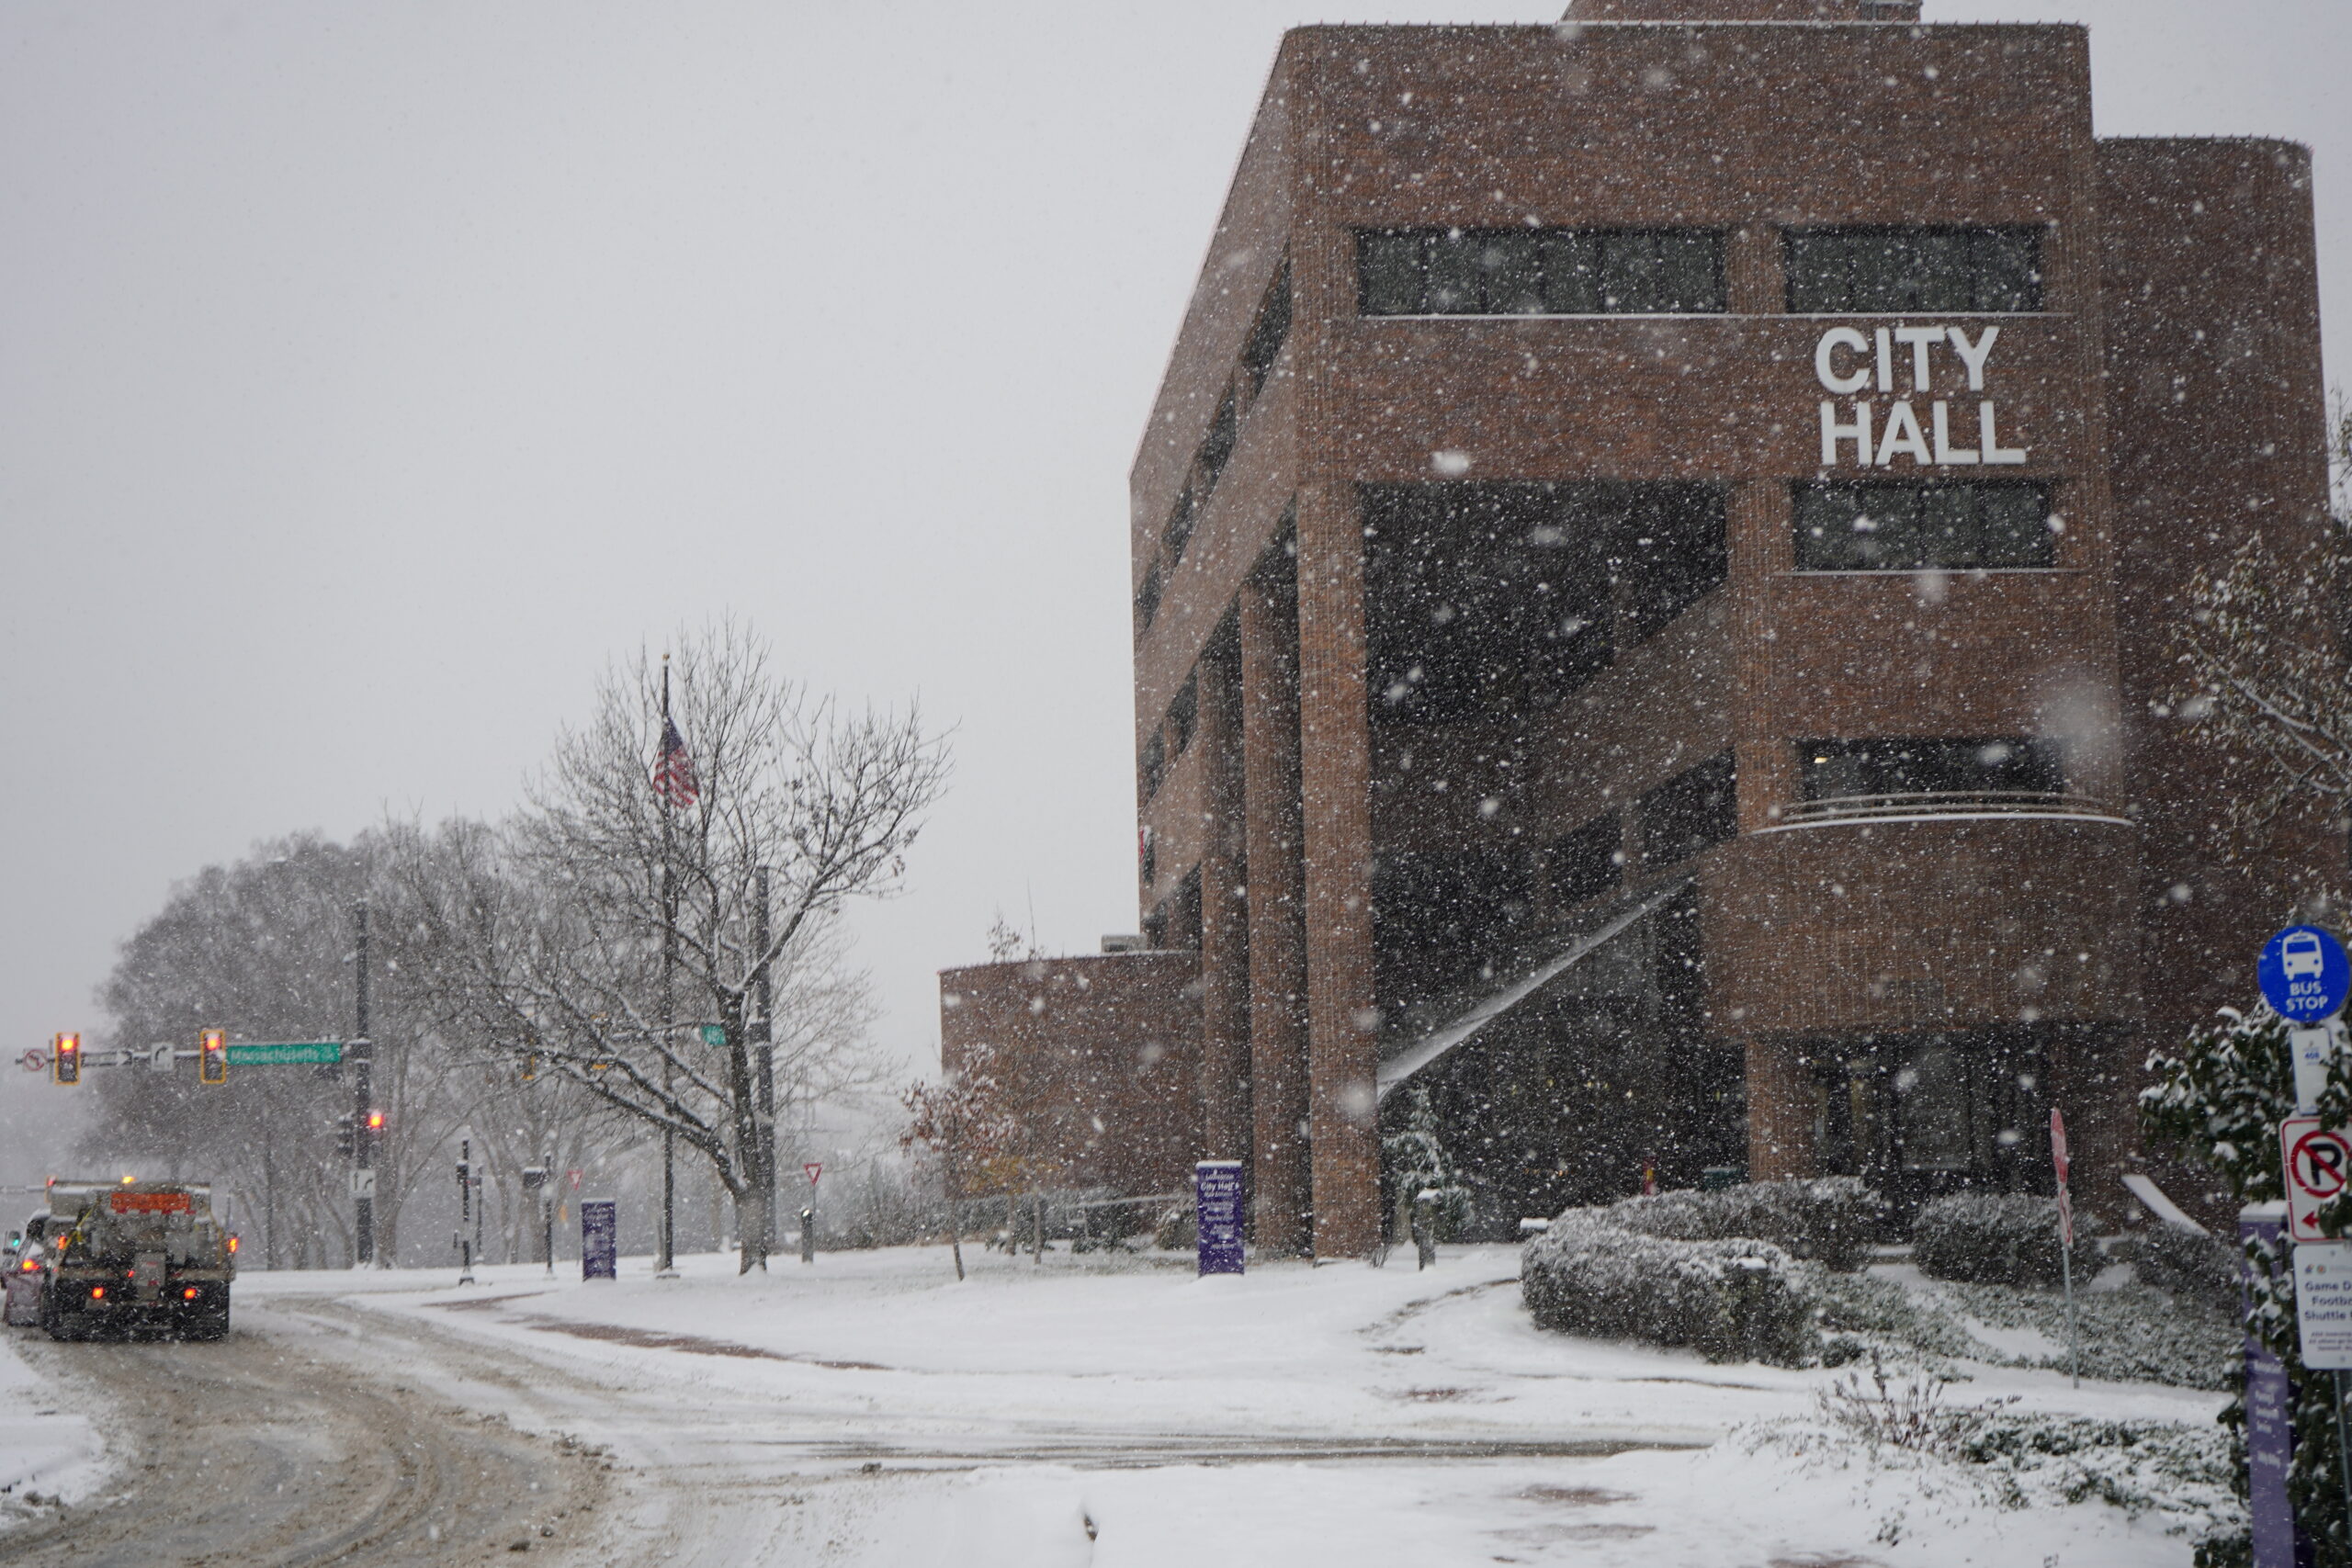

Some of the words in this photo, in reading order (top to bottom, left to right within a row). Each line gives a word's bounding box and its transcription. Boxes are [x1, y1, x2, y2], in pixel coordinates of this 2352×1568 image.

[1815, 326, 2000, 394] CITY
[1820, 400, 2027, 465] HALL
[2290, 980, 2323, 996] BUS
[2286, 995, 2329, 1012] STOP
[2304, 1280, 2338, 1292] Game
[2304, 1310, 2346, 1321] Shuttle
